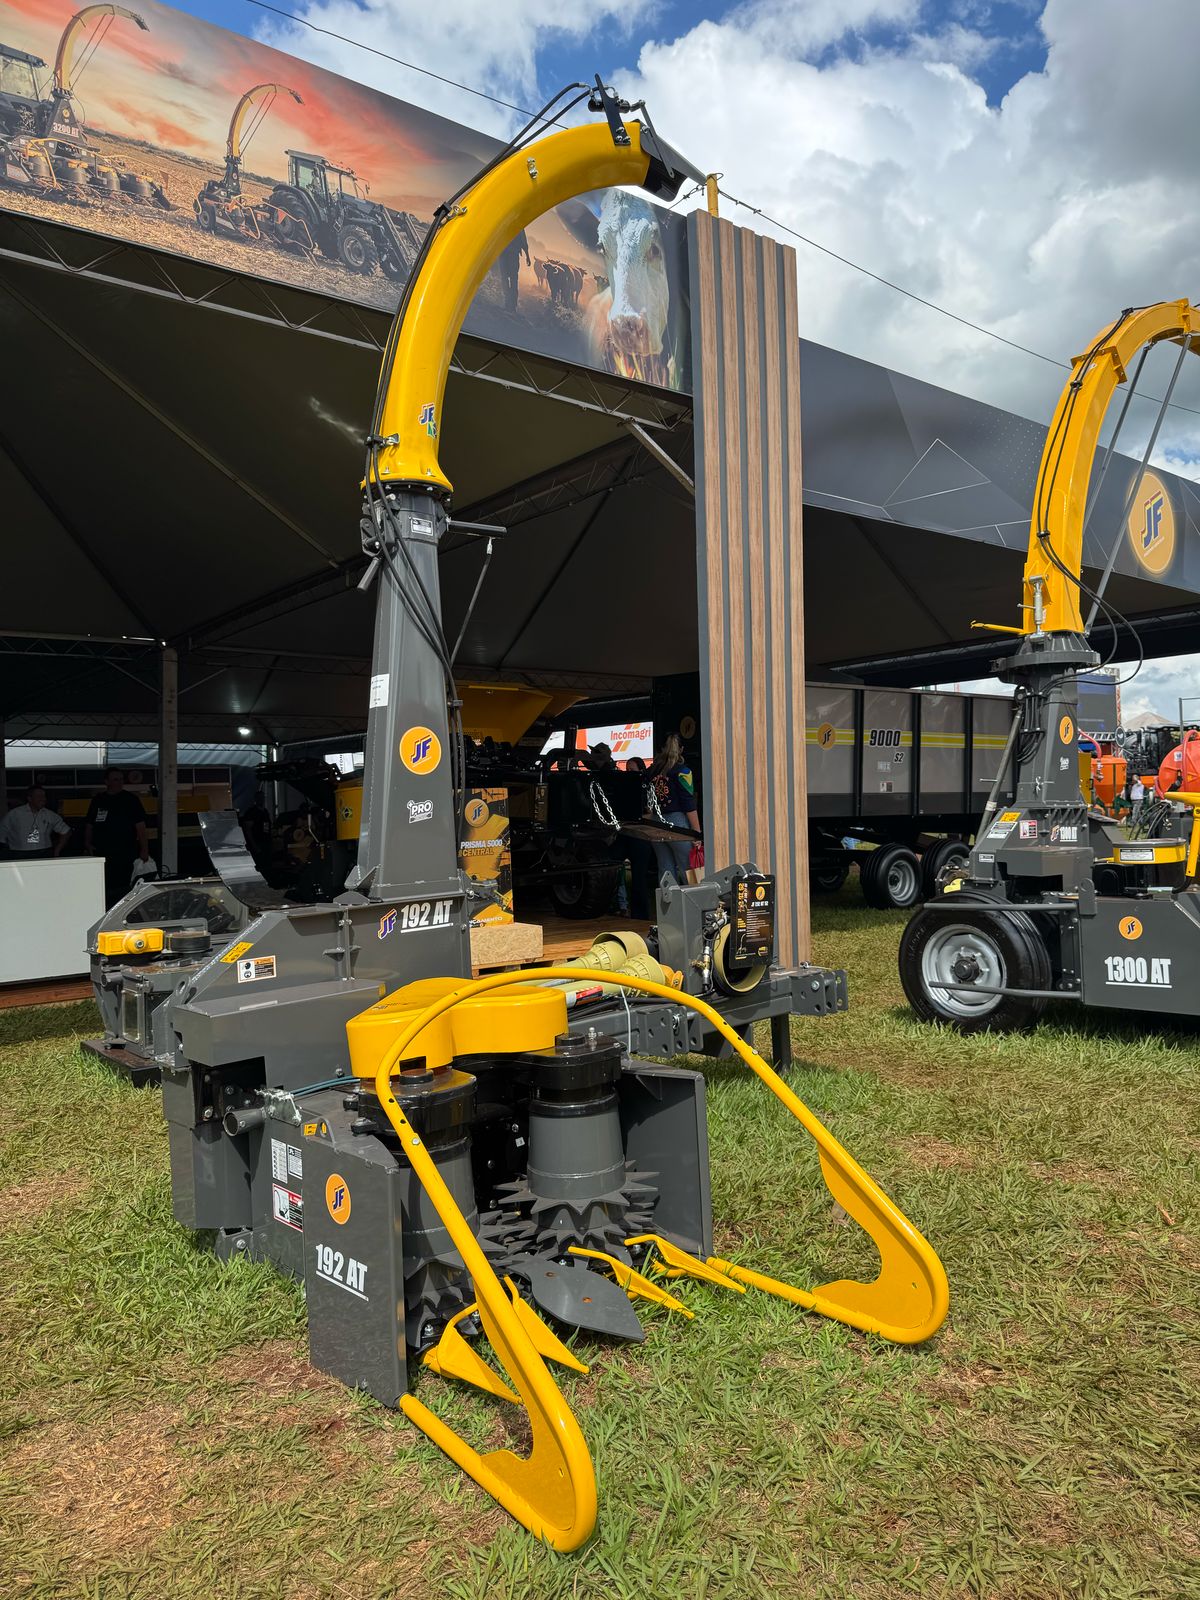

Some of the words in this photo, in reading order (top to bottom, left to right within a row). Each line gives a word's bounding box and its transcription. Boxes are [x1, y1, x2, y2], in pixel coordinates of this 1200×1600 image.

[1140, 490, 1164, 549] JF
[610, 727, 651, 741] Incomagri
[869, 729, 901, 747] 9000
[411, 735, 433, 764] JF
[894, 752, 905, 763] S2
[460, 840, 487, 850] PRISMA
[487, 839, 503, 848] 5000
[462, 848, 495, 857] CENTRAL
[378, 908, 397, 939] JF
[401, 902, 431, 929] 192
[433, 900, 454, 925] AT
[1127, 920, 1137, 936] JF
[1104, 956, 1148, 983] 1300
[1150, 958, 1172, 984] AT
[331, 1184, 346, 1211] JF
[315, 1243, 344, 1282] 192
[346, 1258, 368, 1292] AT
